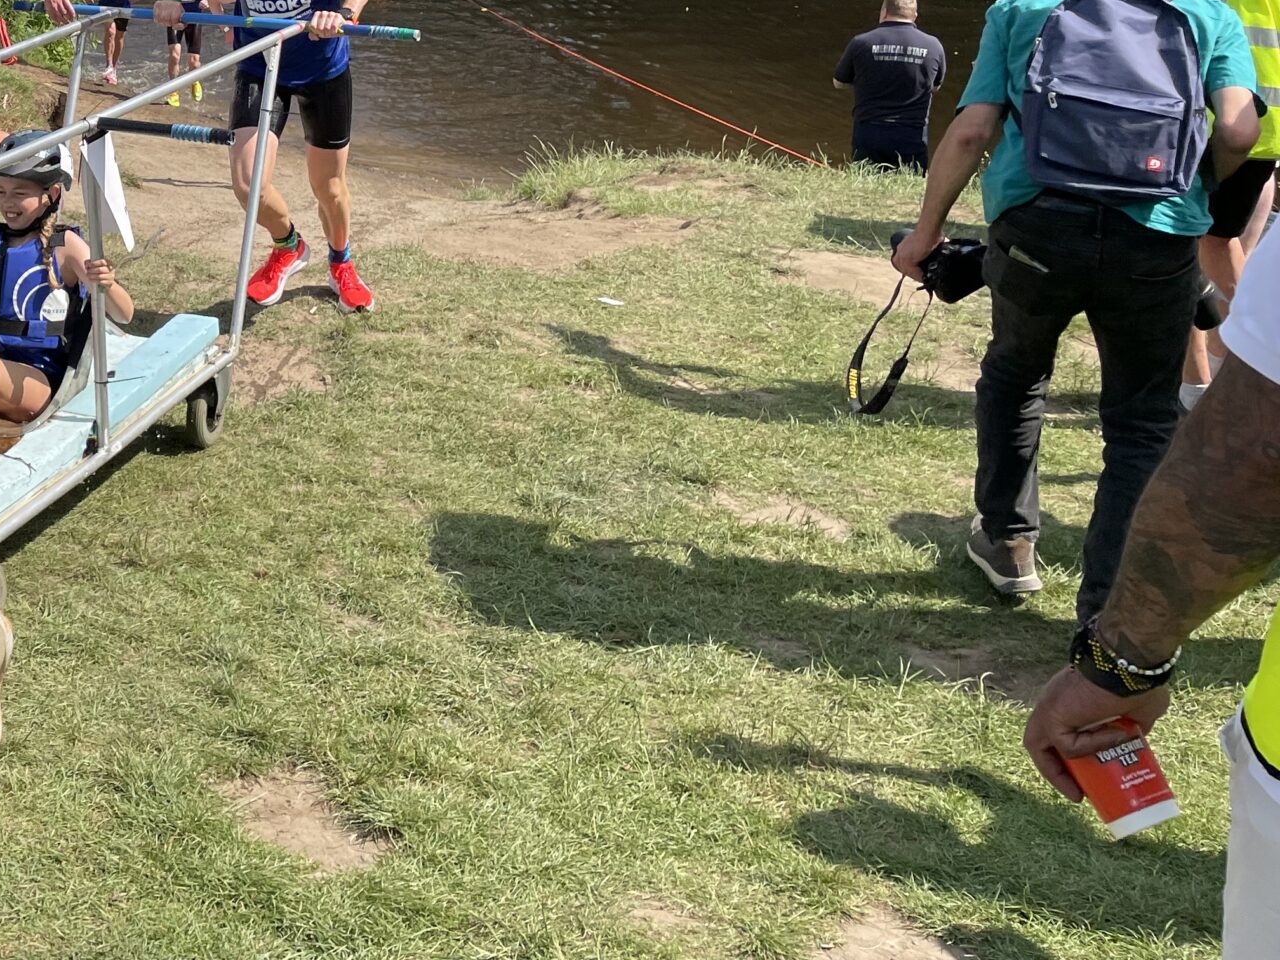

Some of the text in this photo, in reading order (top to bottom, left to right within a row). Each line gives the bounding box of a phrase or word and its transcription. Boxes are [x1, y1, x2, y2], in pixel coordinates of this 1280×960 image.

[906, 46, 928, 58] STAFF
[849, 368, 858, 399] Nikon
[1095, 738, 1145, 763] YORKSHIRE
[1119, 751, 1139, 767] TEA
